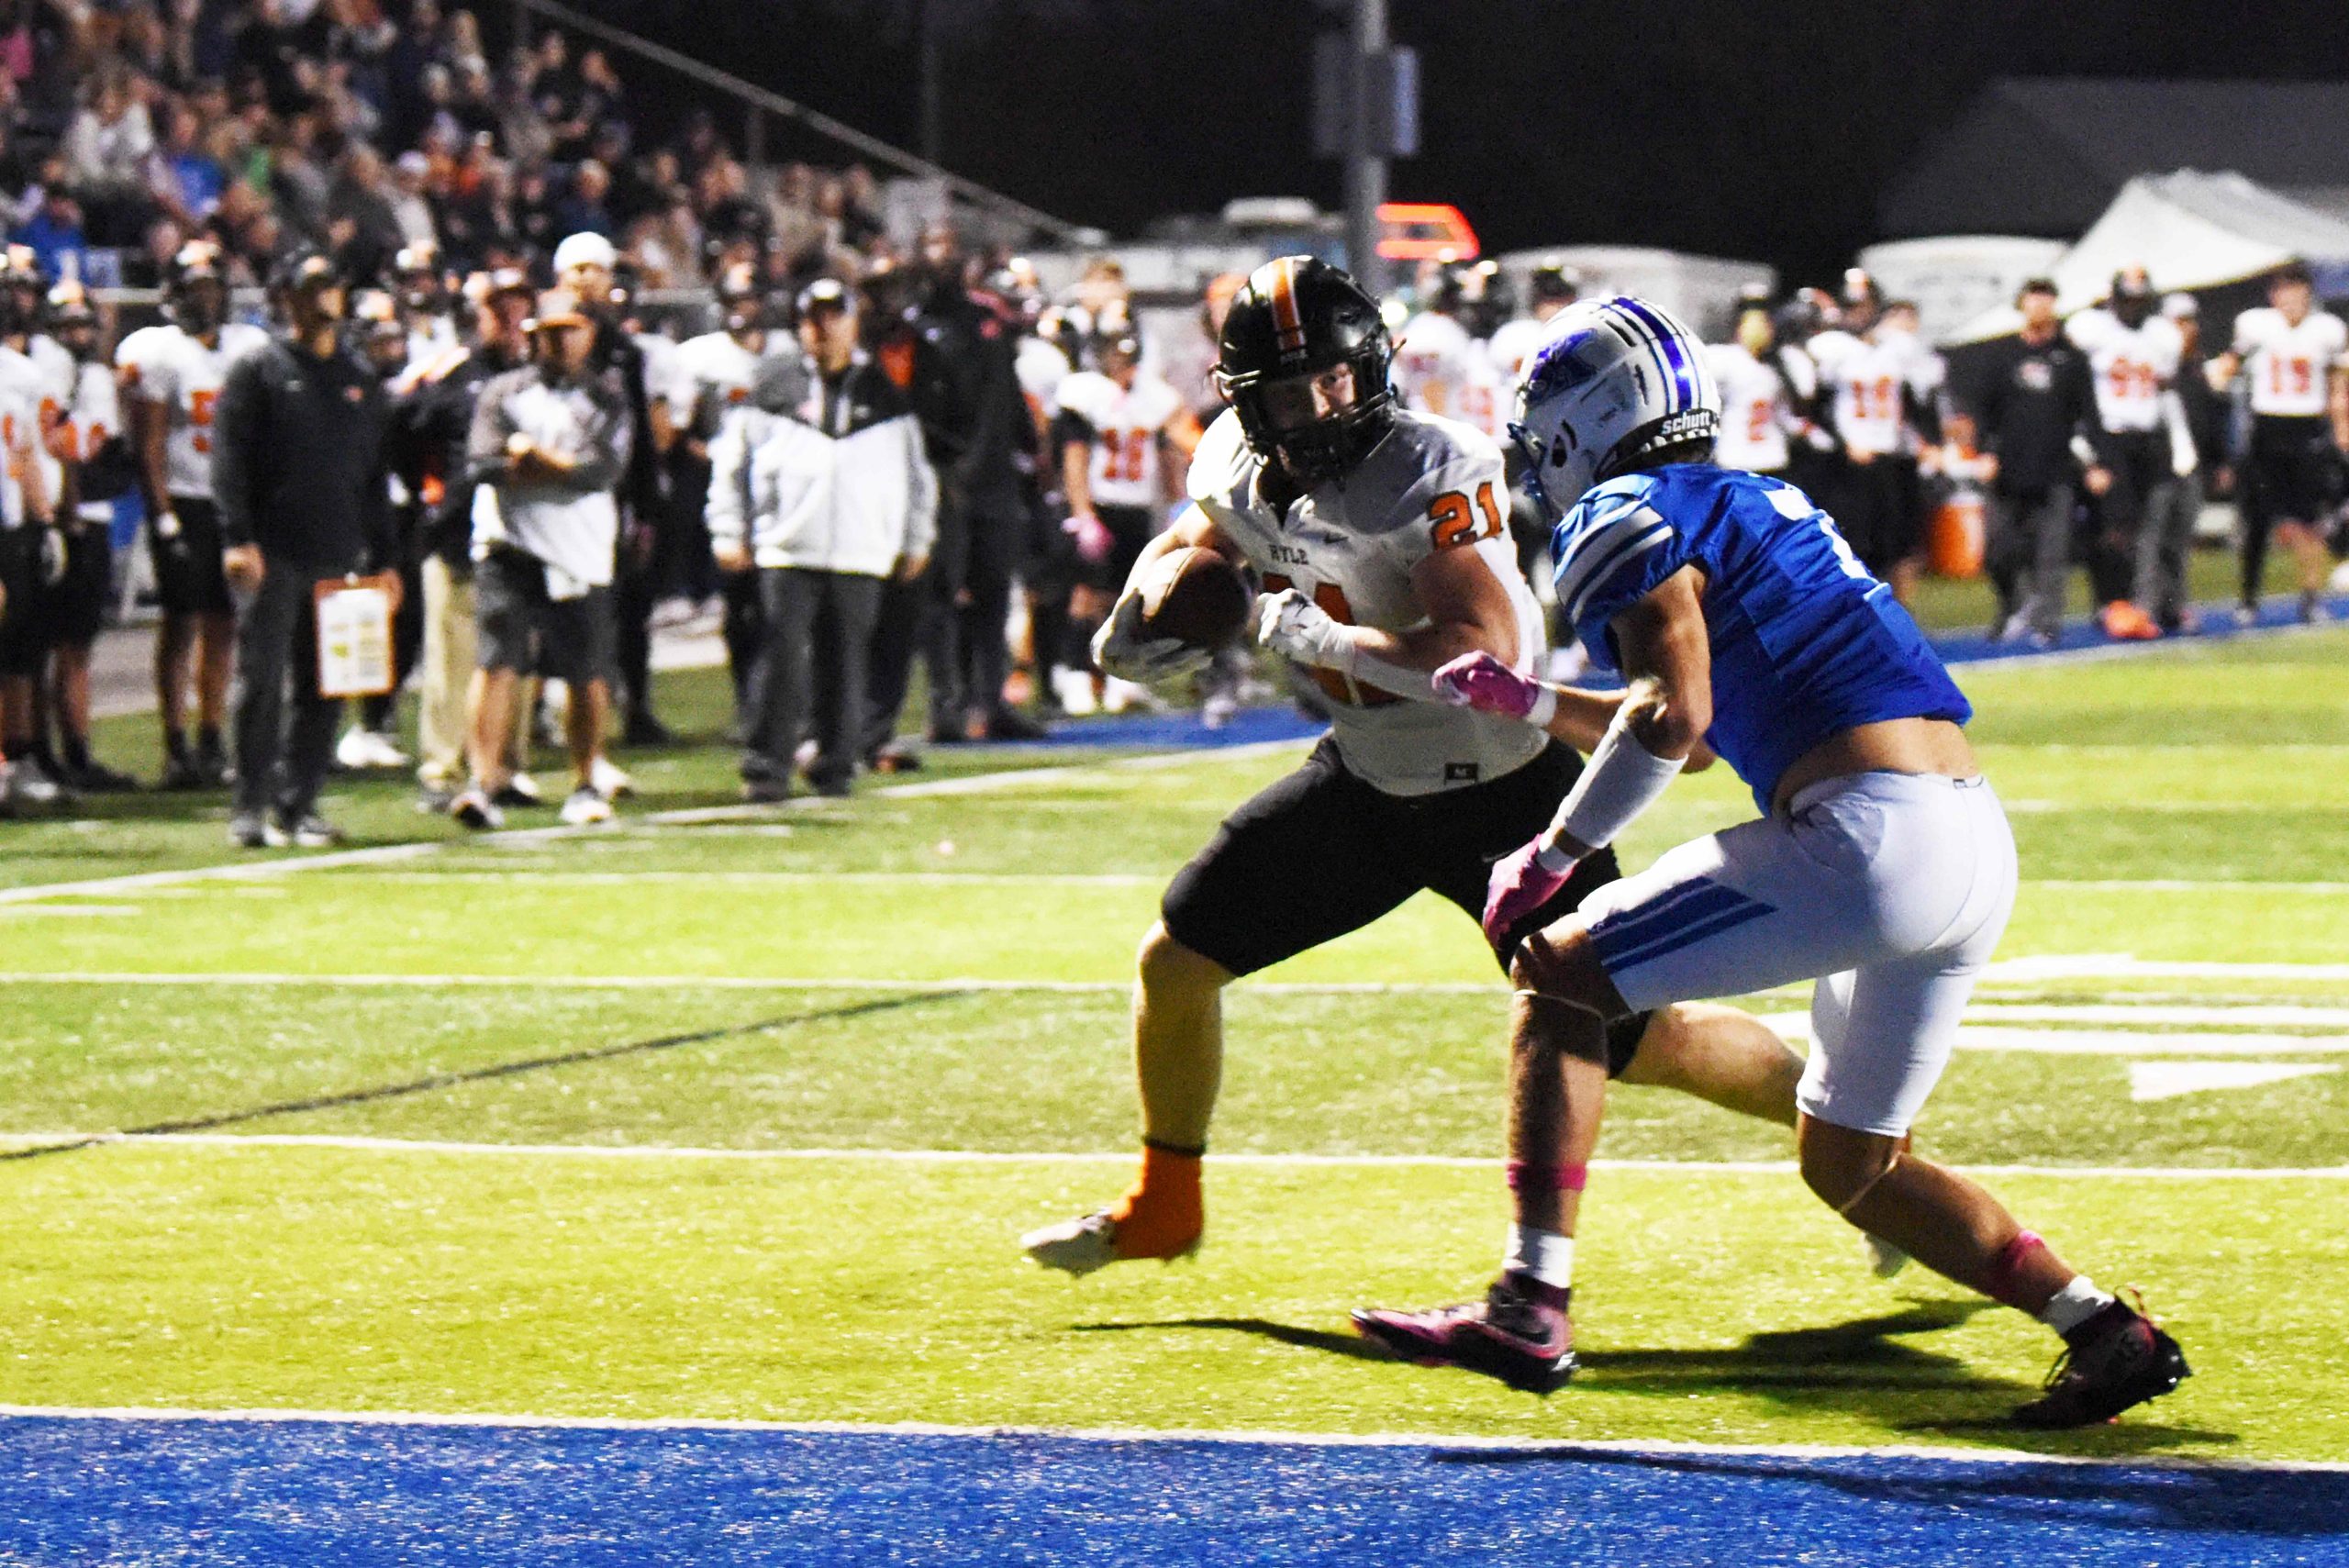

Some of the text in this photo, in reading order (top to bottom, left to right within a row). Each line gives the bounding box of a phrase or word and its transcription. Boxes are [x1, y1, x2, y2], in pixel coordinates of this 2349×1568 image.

[1662, 411, 1710, 436] schutt
[1424, 480, 1504, 551] 21
[1268, 544, 1309, 566] RYLE
